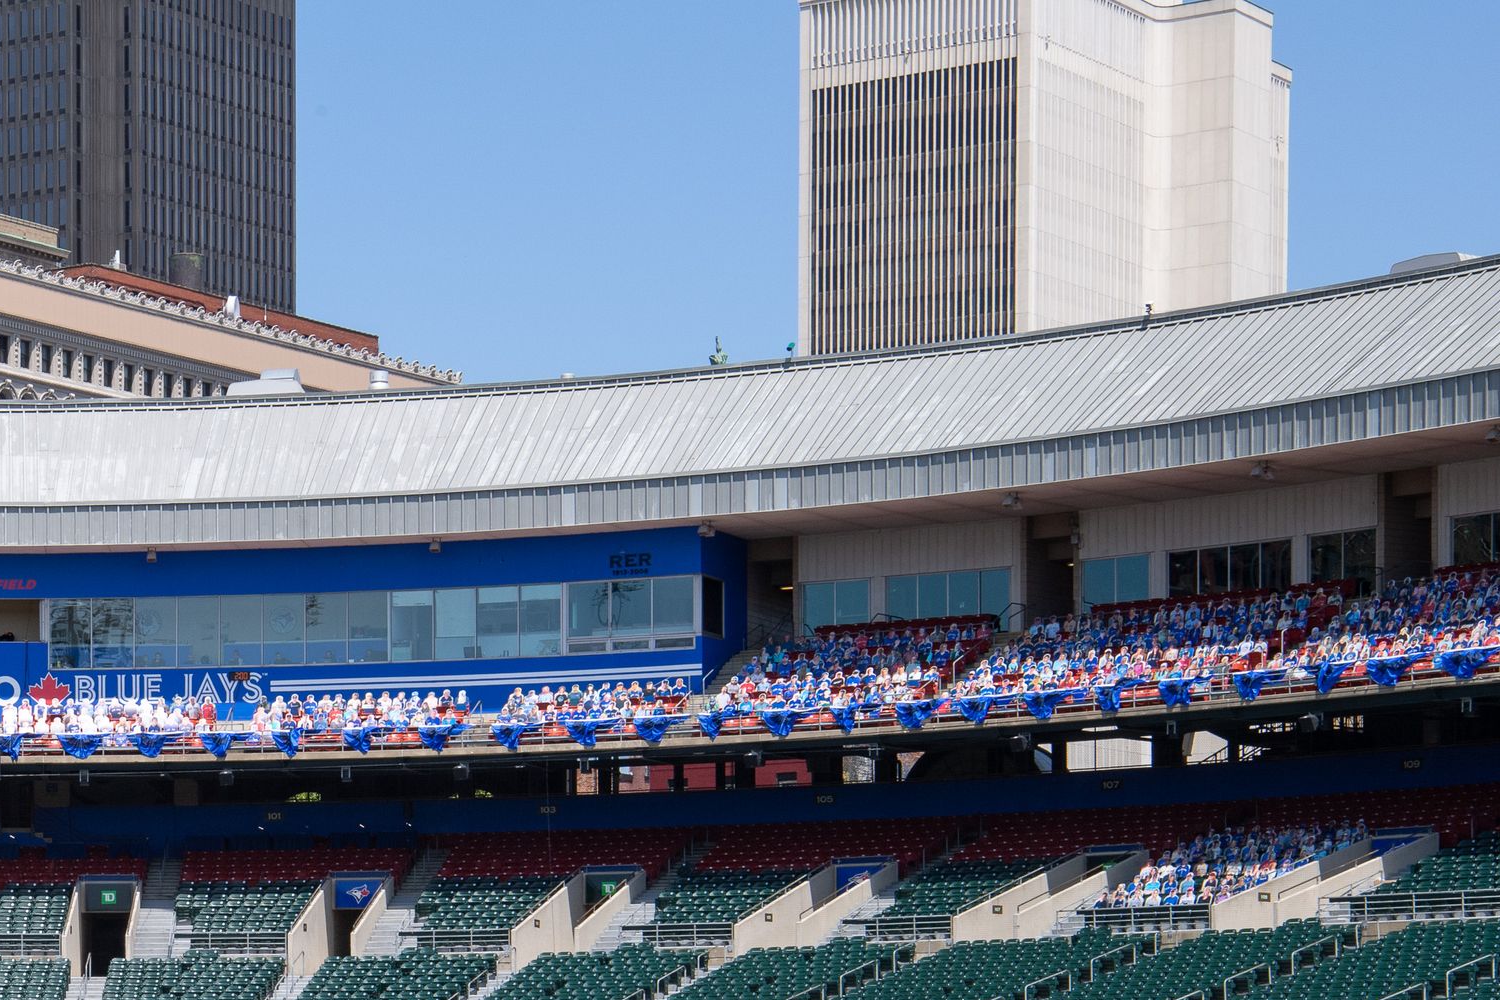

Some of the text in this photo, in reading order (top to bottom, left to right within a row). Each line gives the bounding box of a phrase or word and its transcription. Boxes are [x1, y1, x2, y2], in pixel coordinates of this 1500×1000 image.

[610, 553, 652, 568] RER
[74, 673, 162, 705] BLUE
[176, 671, 263, 704] JAYS
[1403, 760, 1420, 769] 109
[1102, 781, 1119, 789] 107
[817, 795, 833, 803] 105
[540, 806, 556, 814] 103
[102, 893, 115, 902] TD
